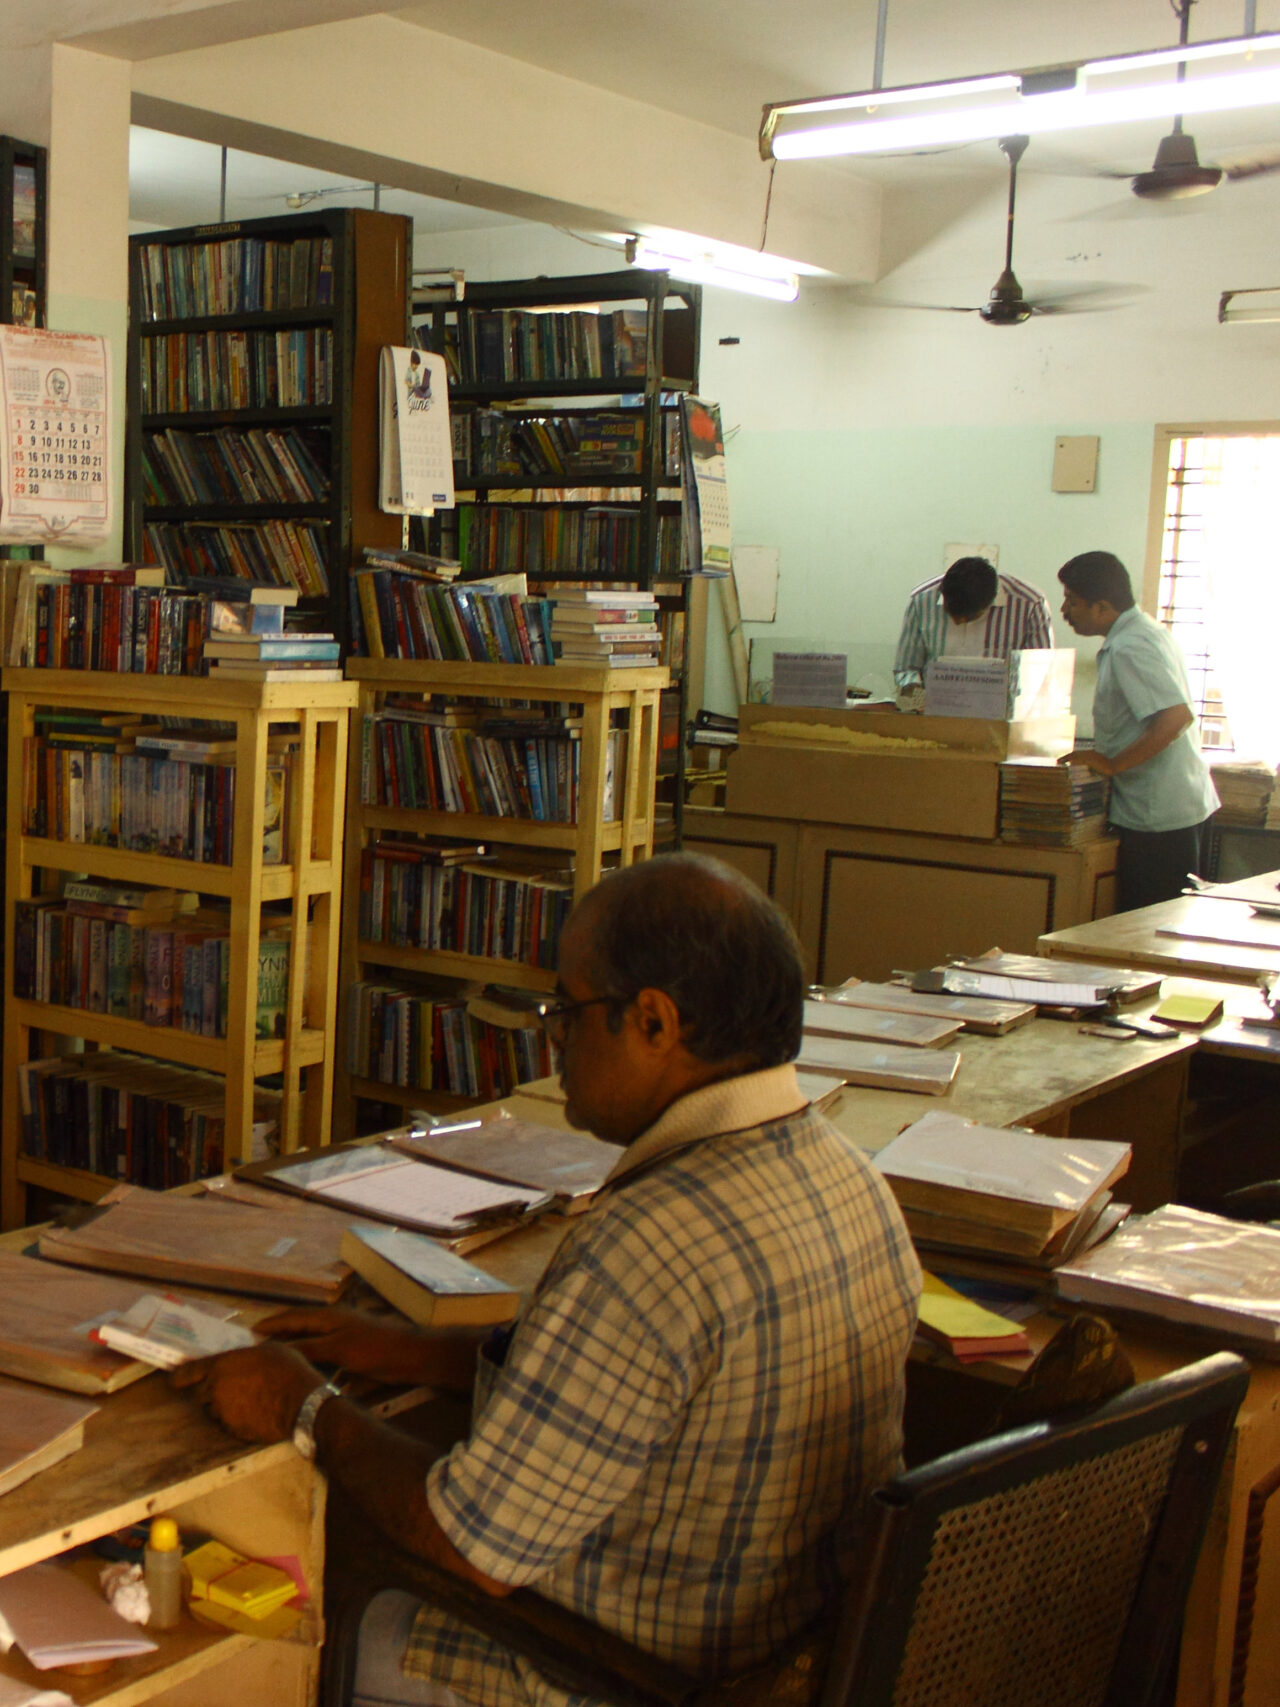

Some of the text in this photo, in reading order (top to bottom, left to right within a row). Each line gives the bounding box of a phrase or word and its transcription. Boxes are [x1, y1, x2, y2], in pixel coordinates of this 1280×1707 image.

[407, 393, 431, 415] June
[42, 437, 51, 447] 10
[56, 438, 64, 448] 11
[69, 440, 77, 449] 12
[82, 440, 90, 450] 13
[14, 451, 101, 466] 15 16 17 18 19 20 21
[16, 468, 101, 481] 22 23 24 25 26 27 28
[15, 483, 39, 494] 29 30
